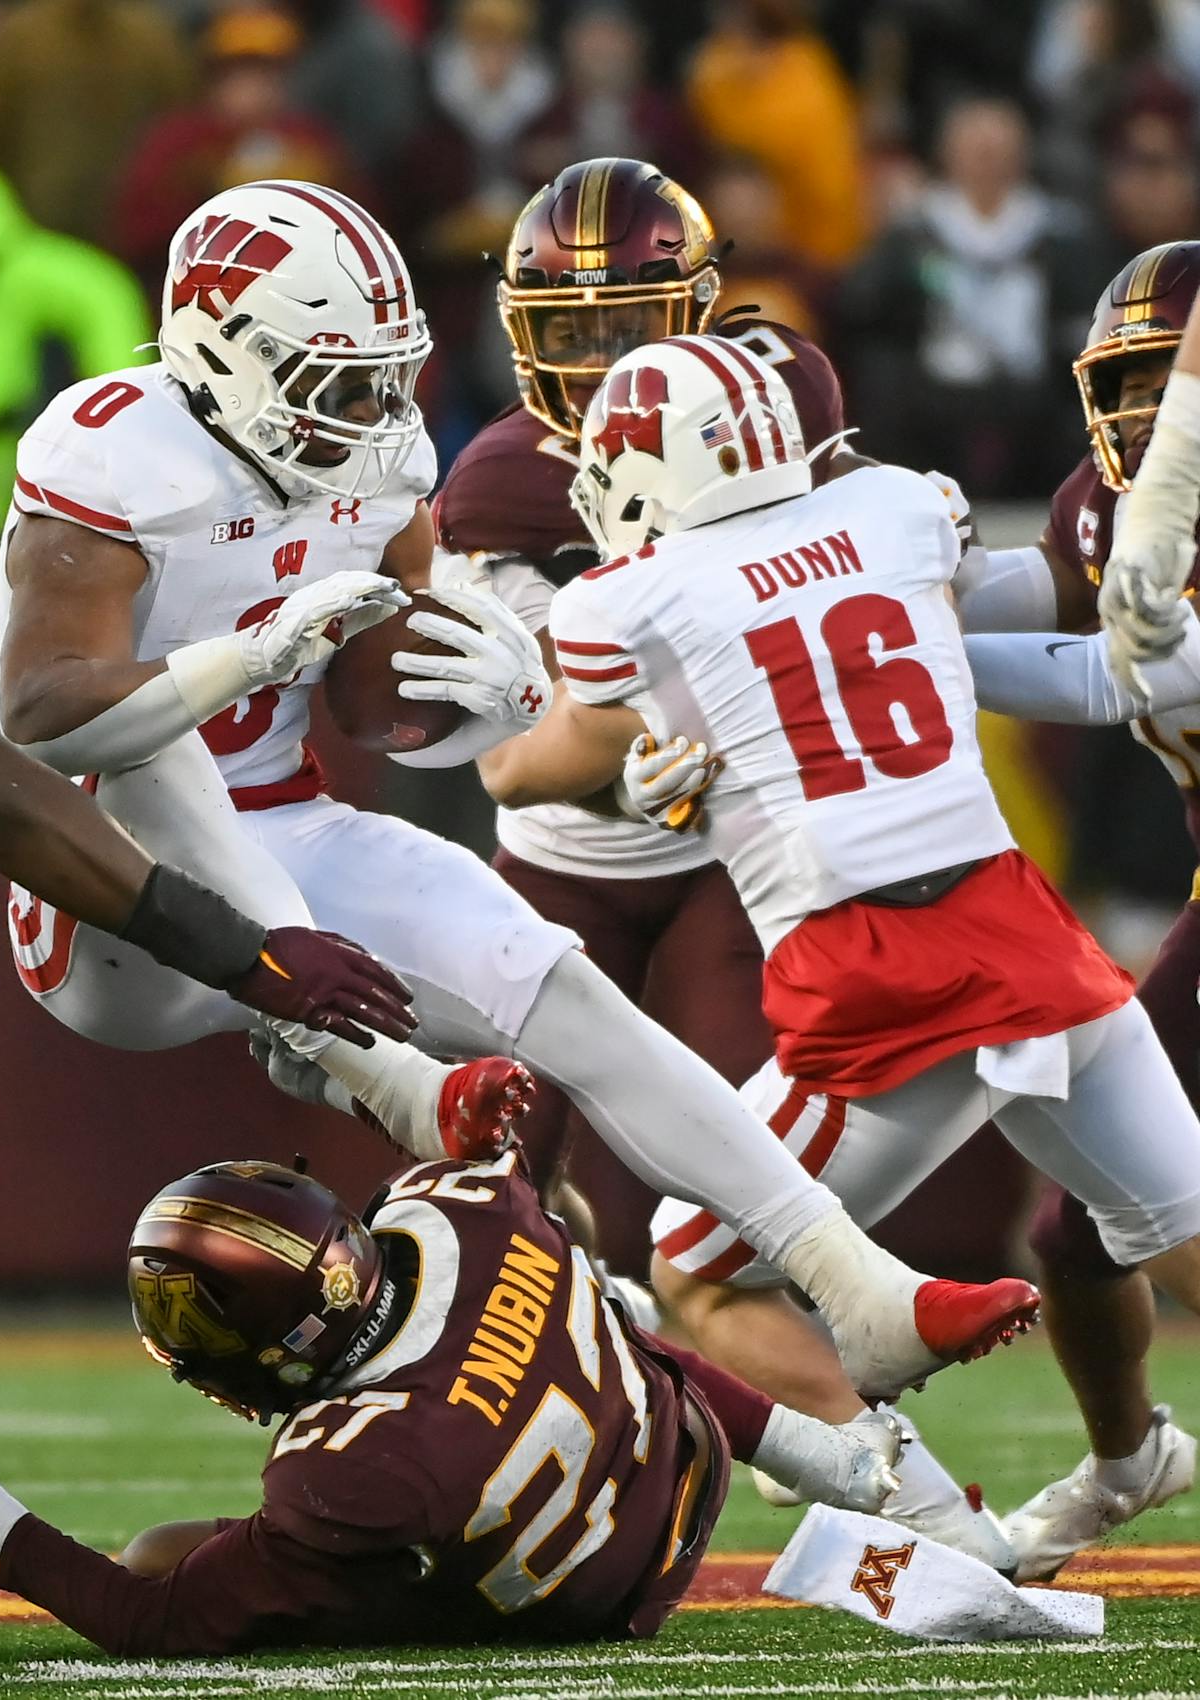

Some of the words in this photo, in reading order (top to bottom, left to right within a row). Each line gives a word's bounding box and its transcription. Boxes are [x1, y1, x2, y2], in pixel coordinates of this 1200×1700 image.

[575, 269, 608, 285] ROW
[72, 380, 146, 429] 0
[272, 539, 308, 583] W
[738, 529, 865, 603] DUNN
[742, 592, 955, 803] 16
[344, 1279, 398, 1367] SKI-U-MAH
[447, 1233, 562, 1428] T.NUBIN
